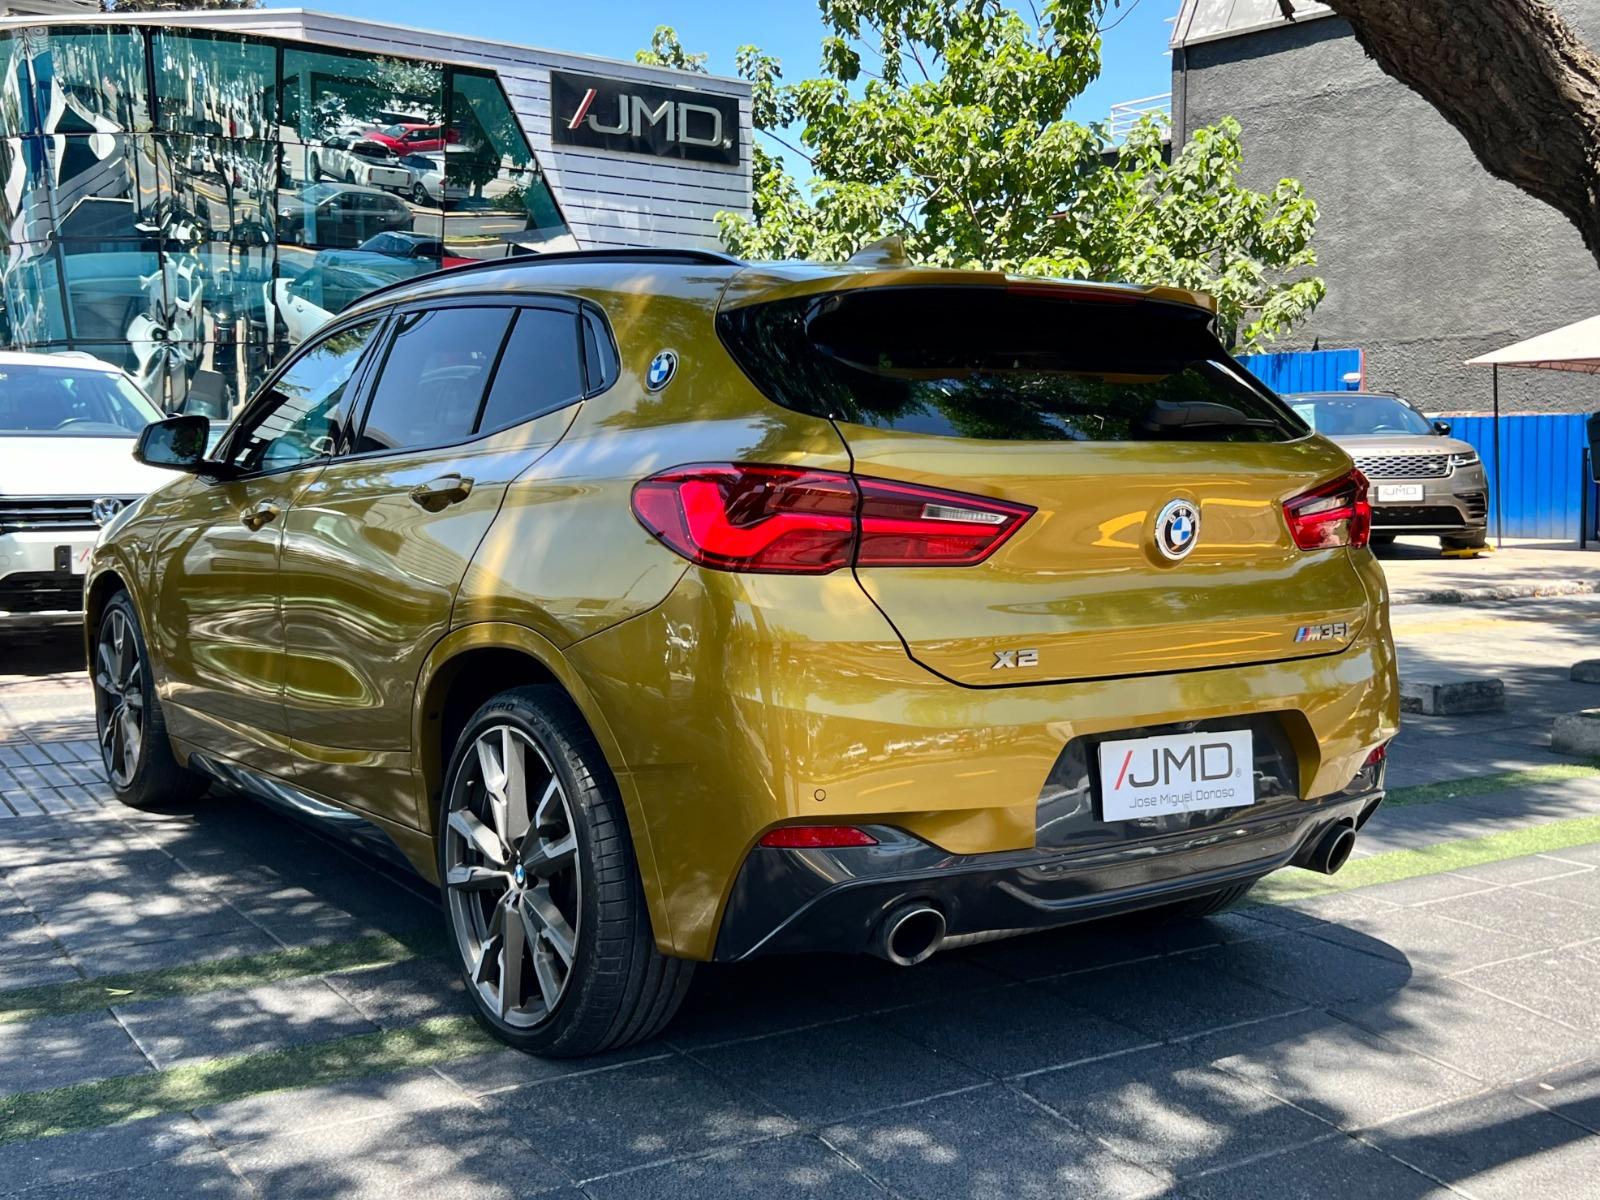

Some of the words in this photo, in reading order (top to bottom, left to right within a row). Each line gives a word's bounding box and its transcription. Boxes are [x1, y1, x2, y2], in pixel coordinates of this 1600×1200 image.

[991, 649, 1038, 669] X2
[1129, 796, 1157, 809] Jose
[1160, 790, 1194, 807] Miguel
[1196, 787, 1235, 801] Donoso
